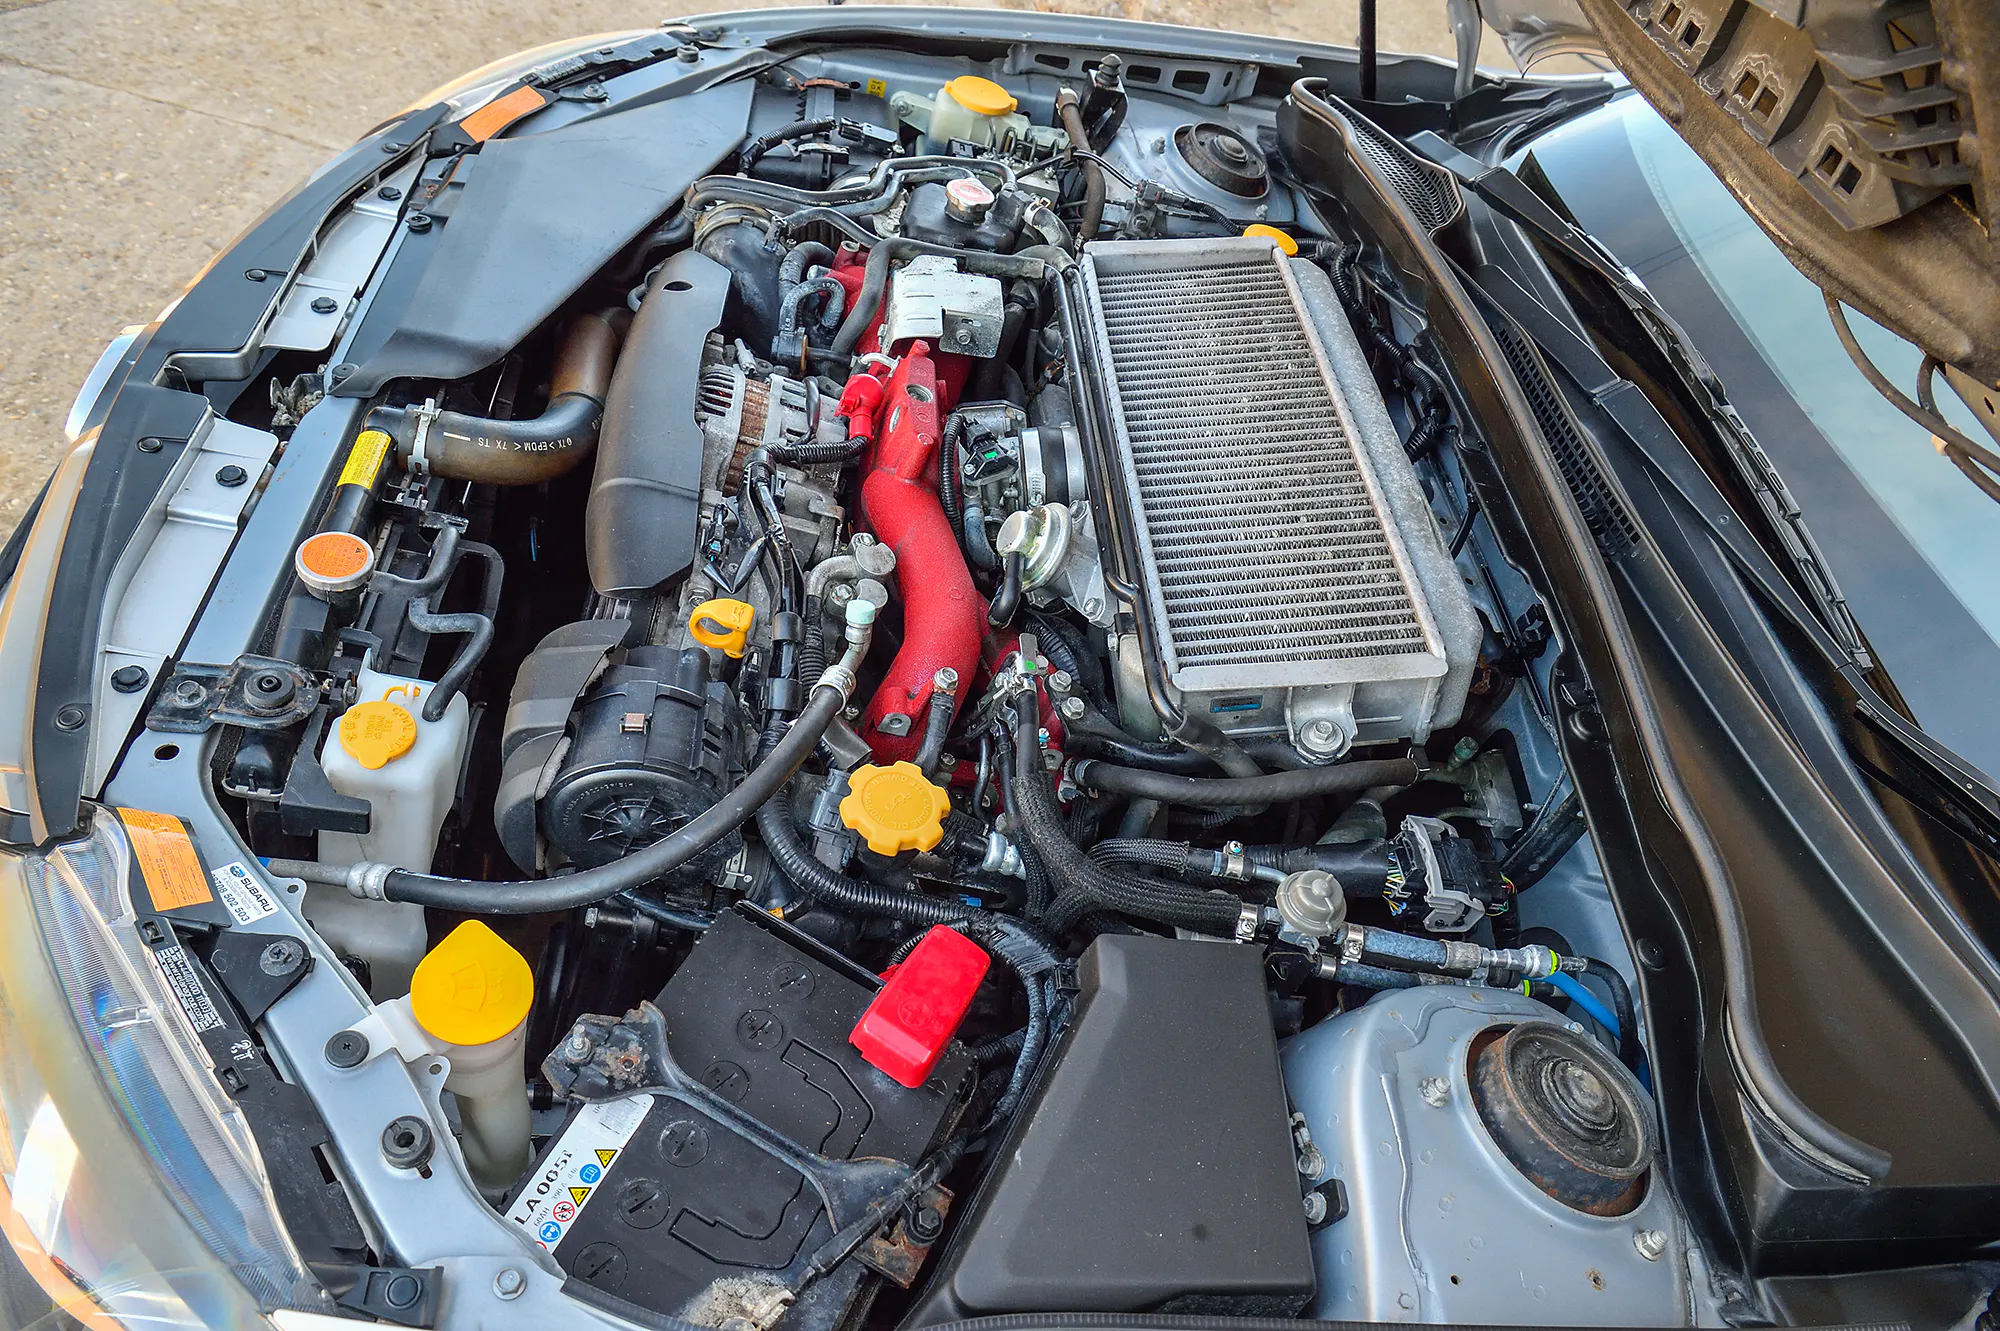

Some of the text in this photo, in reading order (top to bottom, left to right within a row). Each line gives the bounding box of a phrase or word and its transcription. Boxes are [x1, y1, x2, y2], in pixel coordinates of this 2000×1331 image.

[478, 437, 490, 447] TS
[496, 439, 507, 450] 7X
[387, 708, 413, 753] COOLANT
[892, 798, 931, 829] ENGINE OIL
[224, 893, 238, 907] 502
[234, 907, 250, 922] 503
[242, 877, 273, 912] SUBARU
